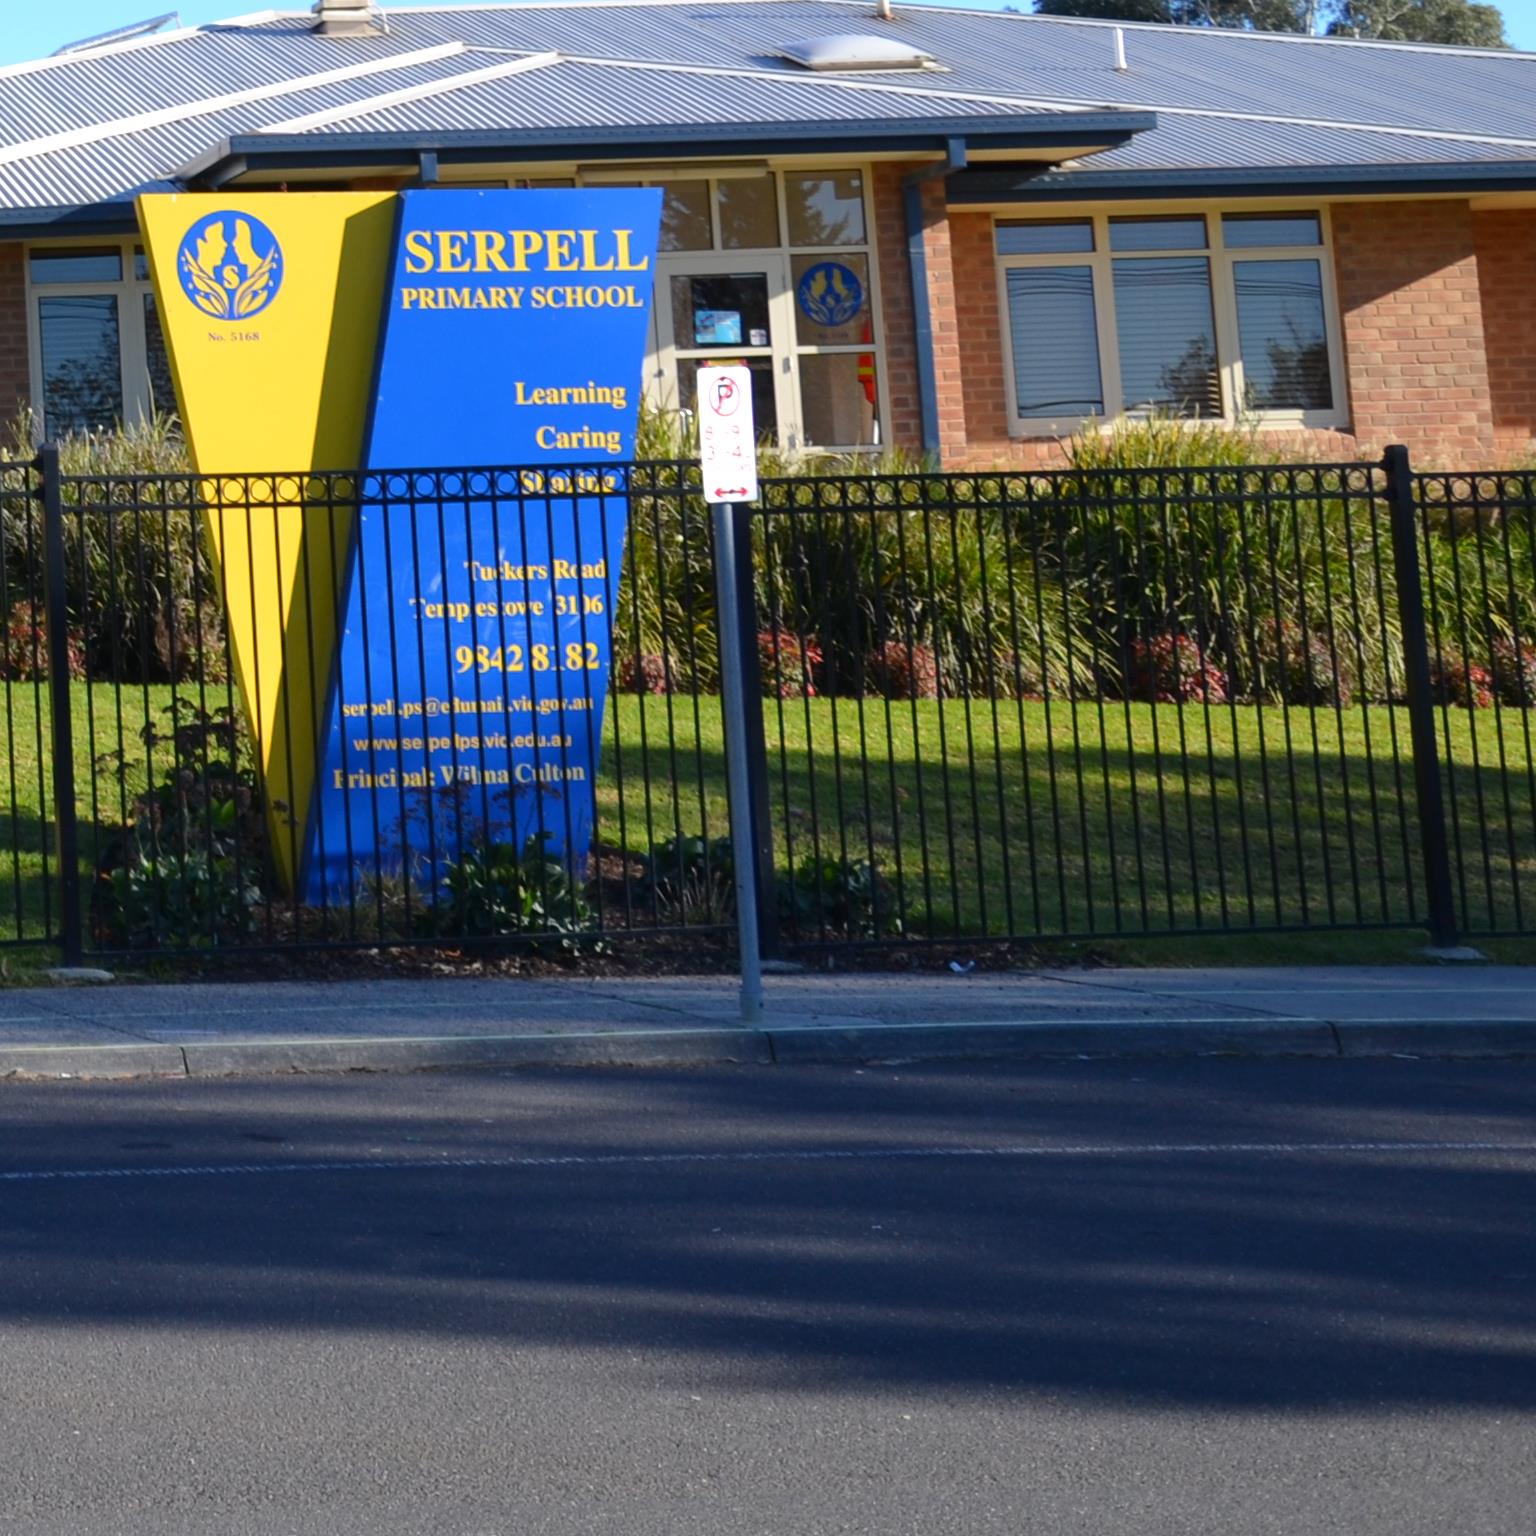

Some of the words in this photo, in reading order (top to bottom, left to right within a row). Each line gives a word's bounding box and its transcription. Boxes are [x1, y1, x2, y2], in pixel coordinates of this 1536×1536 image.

[405, 230, 649, 273] SERPELL
[401, 287, 525, 309] PRIMARY
[531, 286, 644, 308] SCHOOL
[231, 332, 260, 341] 5168
[514, 381, 627, 409] Learning
[536, 425, 622, 454] Caring
[553, 559, 608, 579] Road
[409, 598, 544, 623] empesowe
[456, 645, 524, 673] 9842
[343, 695, 594, 719] serel.ps@eumai.vic.gov.au
[354, 733, 572, 752] wwwsepelpsvic.edu.au
